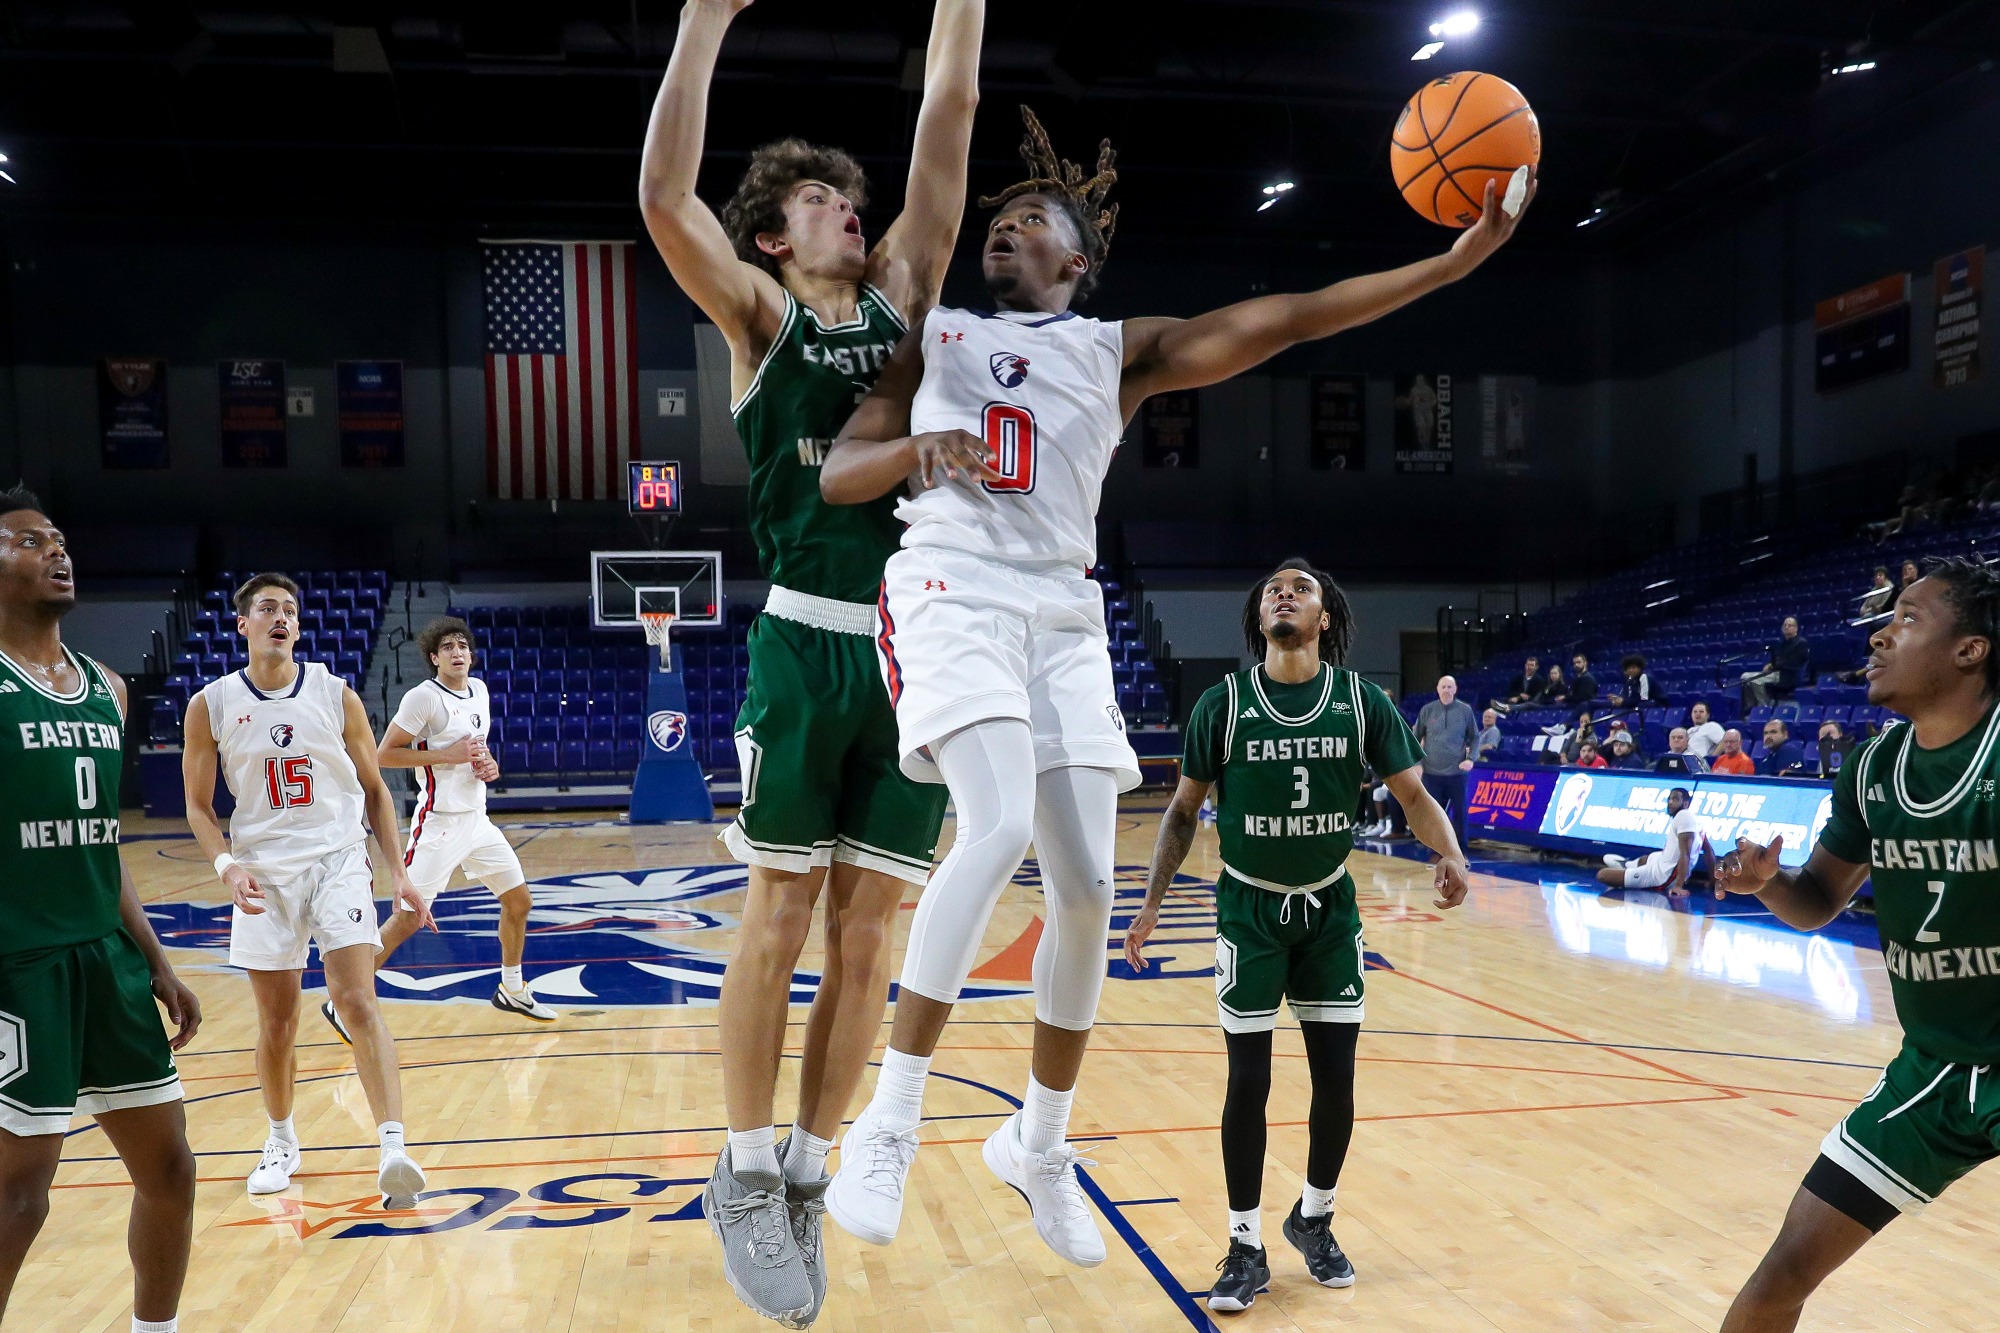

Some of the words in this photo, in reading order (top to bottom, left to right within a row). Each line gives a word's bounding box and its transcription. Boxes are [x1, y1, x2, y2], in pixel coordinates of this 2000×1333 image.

[296, 399, 304, 413] 6
[659, 390, 684, 398] SECTION
[668, 400, 676, 413] 7
[798, 437, 837, 466] NE
[981, 401, 1037, 495] 0
[660, 466, 675, 481] 17
[638, 482, 672, 509] 09
[18, 720, 121, 751] EASTERN
[1246, 736, 1348, 761] EASTERN
[74, 756, 97, 810] 0
[265, 753, 315, 810] 15
[1291, 766, 1310, 809] 3
[1504, 771, 1525, 781] TYLER
[1471, 781, 1535, 809] PATRIOTS
[1627, 786, 1707, 816] WELCE
[1702, 791, 1729, 815] TO
[1726, 793, 1767, 819] THE
[20, 819, 73, 849] NEW
[77, 818, 119, 846] MEX
[1245, 814, 1282, 837] NEW
[1736, 819, 1808, 850] CENTER
[1871, 838, 1998, 872] EASTERN
[1915, 880, 1945, 943] 2
